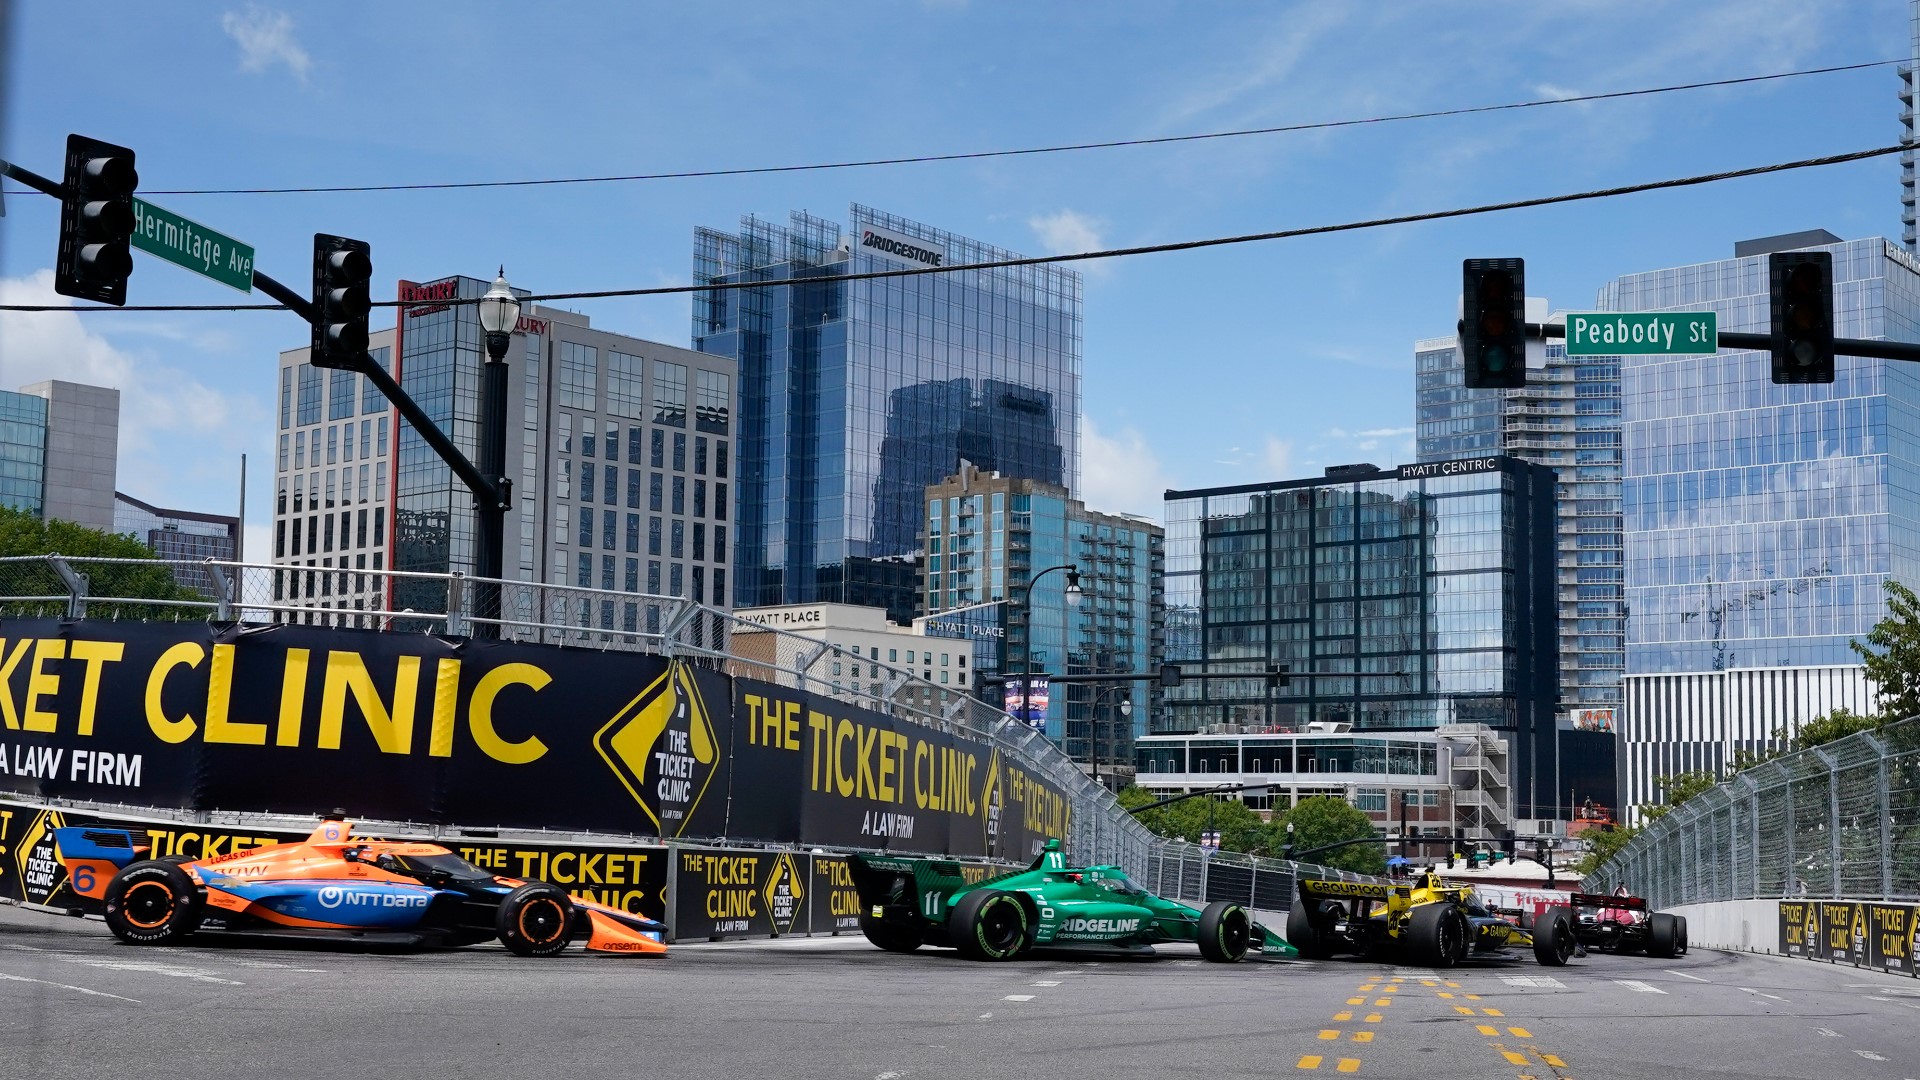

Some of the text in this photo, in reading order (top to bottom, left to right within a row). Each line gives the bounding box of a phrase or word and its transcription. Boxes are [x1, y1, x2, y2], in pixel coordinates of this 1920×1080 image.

[134, 202, 251, 276] Hermitage Ave
[863, 231, 942, 267] BRIDGESTONE
[514, 316, 548, 334] URY
[1575, 318, 1707, 350] Peabody St
[1403, 458, 1495, 477] HYATT CENTRIC
[746, 610, 820, 624] HYATT PLACE
[937, 622, 1004, 637] HYATT PLACE
[145, 641, 553, 765] CLINIC
[669, 729, 688, 754] THE
[15, 744, 63, 780] LAW
[71, 750, 142, 787] FIRM
[655, 752, 695, 779] TICKET
[744, 694, 977, 817] THE TICKET CLINIC
[657, 777, 691, 803] CLINIC
[1009, 767, 1024, 802] THE
[325, 824, 340, 841] 6
[861, 810, 914, 839] A LAW FIRM
[36, 846, 53, 860] THE
[210, 850, 255, 865] LUCAS OIL
[684, 854, 703, 872] THE
[1049, 852, 1063, 869] 11
[28, 858, 58, 874] TICKET
[459, 847, 648, 884] THE TICKET
[705, 856, 758, 885] TICKET
[816, 859, 829, 875] THE
[830, 861, 855, 887] TICK
[26, 871, 54, 887] CLINIC
[74, 865, 97, 893] 6
[778, 884, 789, 895] THE
[346, 892, 382, 906] NTT
[706, 889, 757, 919] CLINIC
[774, 896, 793, 906] TICKET
[925, 890, 942, 915] 11
[774, 906, 792, 917] CLINIC
[1881, 909, 1905, 931] TICKET
[715, 920, 749, 932] A LAW FIRM
[1059, 918, 1140, 932] RIDGELINE
[1882, 933, 1905, 958] CLINIC
